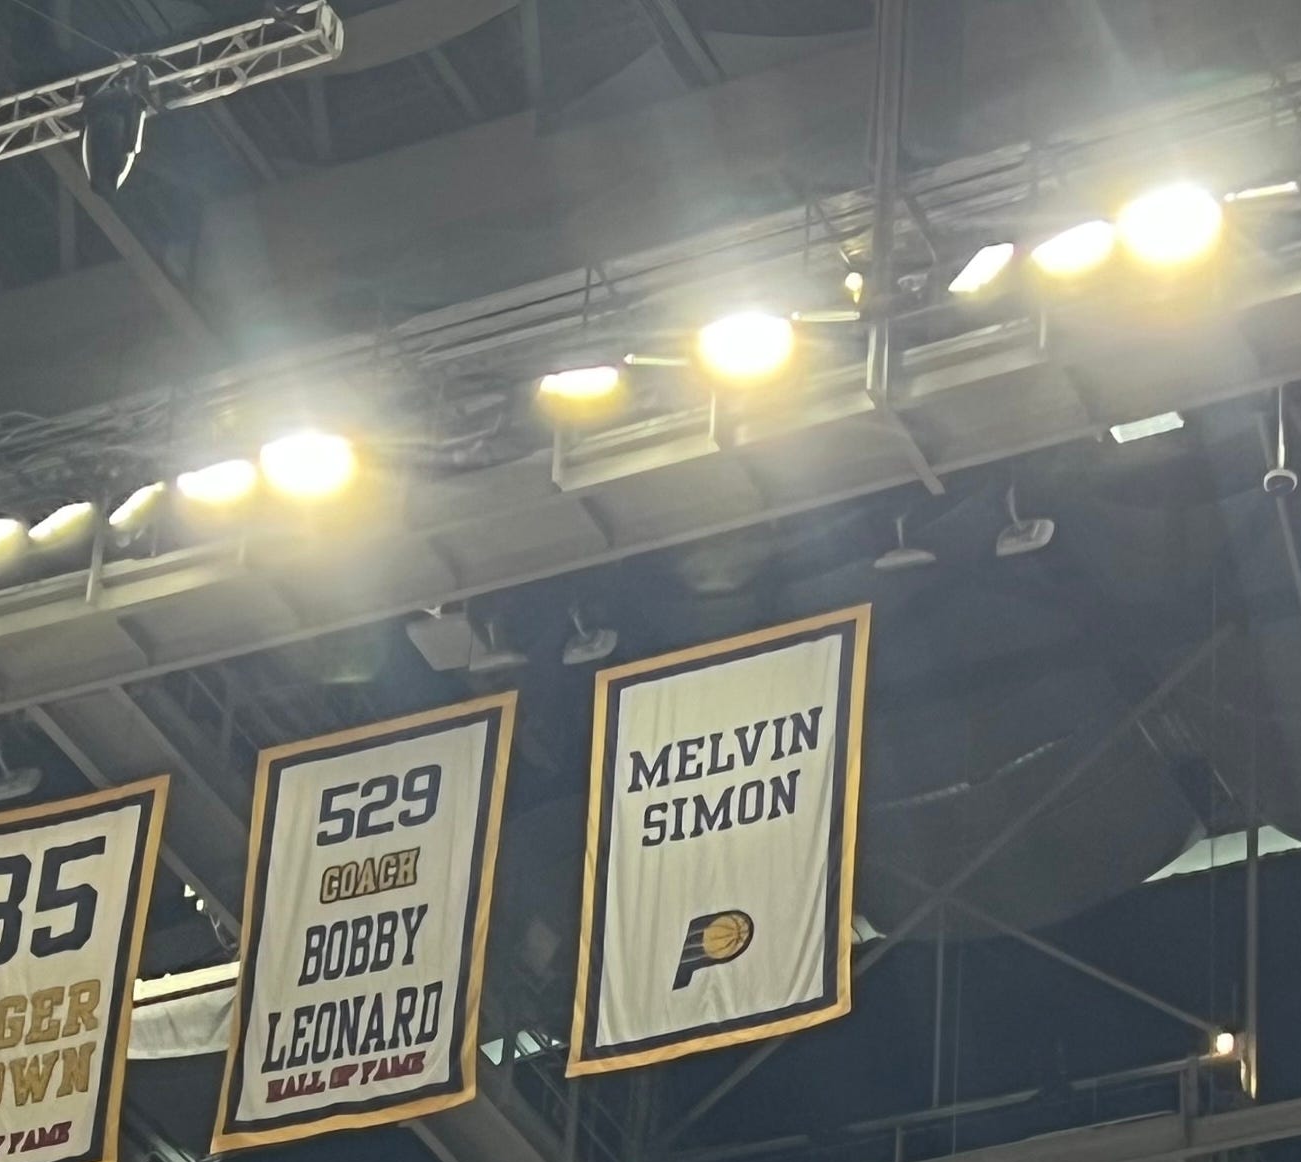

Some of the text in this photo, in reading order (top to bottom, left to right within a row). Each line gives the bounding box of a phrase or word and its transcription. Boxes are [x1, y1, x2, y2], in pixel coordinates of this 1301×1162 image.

[627, 706, 823, 793] MELVIN
[316, 764, 441, 847] 529
[641, 769, 800, 847] SIMON
[319, 846, 420, 904] COACH
[298, 904, 430, 986] BOBBY
[261, 981, 443, 1074] LEONARD
[266, 1050, 426, 1103] HALL OF FAME
[7, 1121, 72, 1155] FAME
